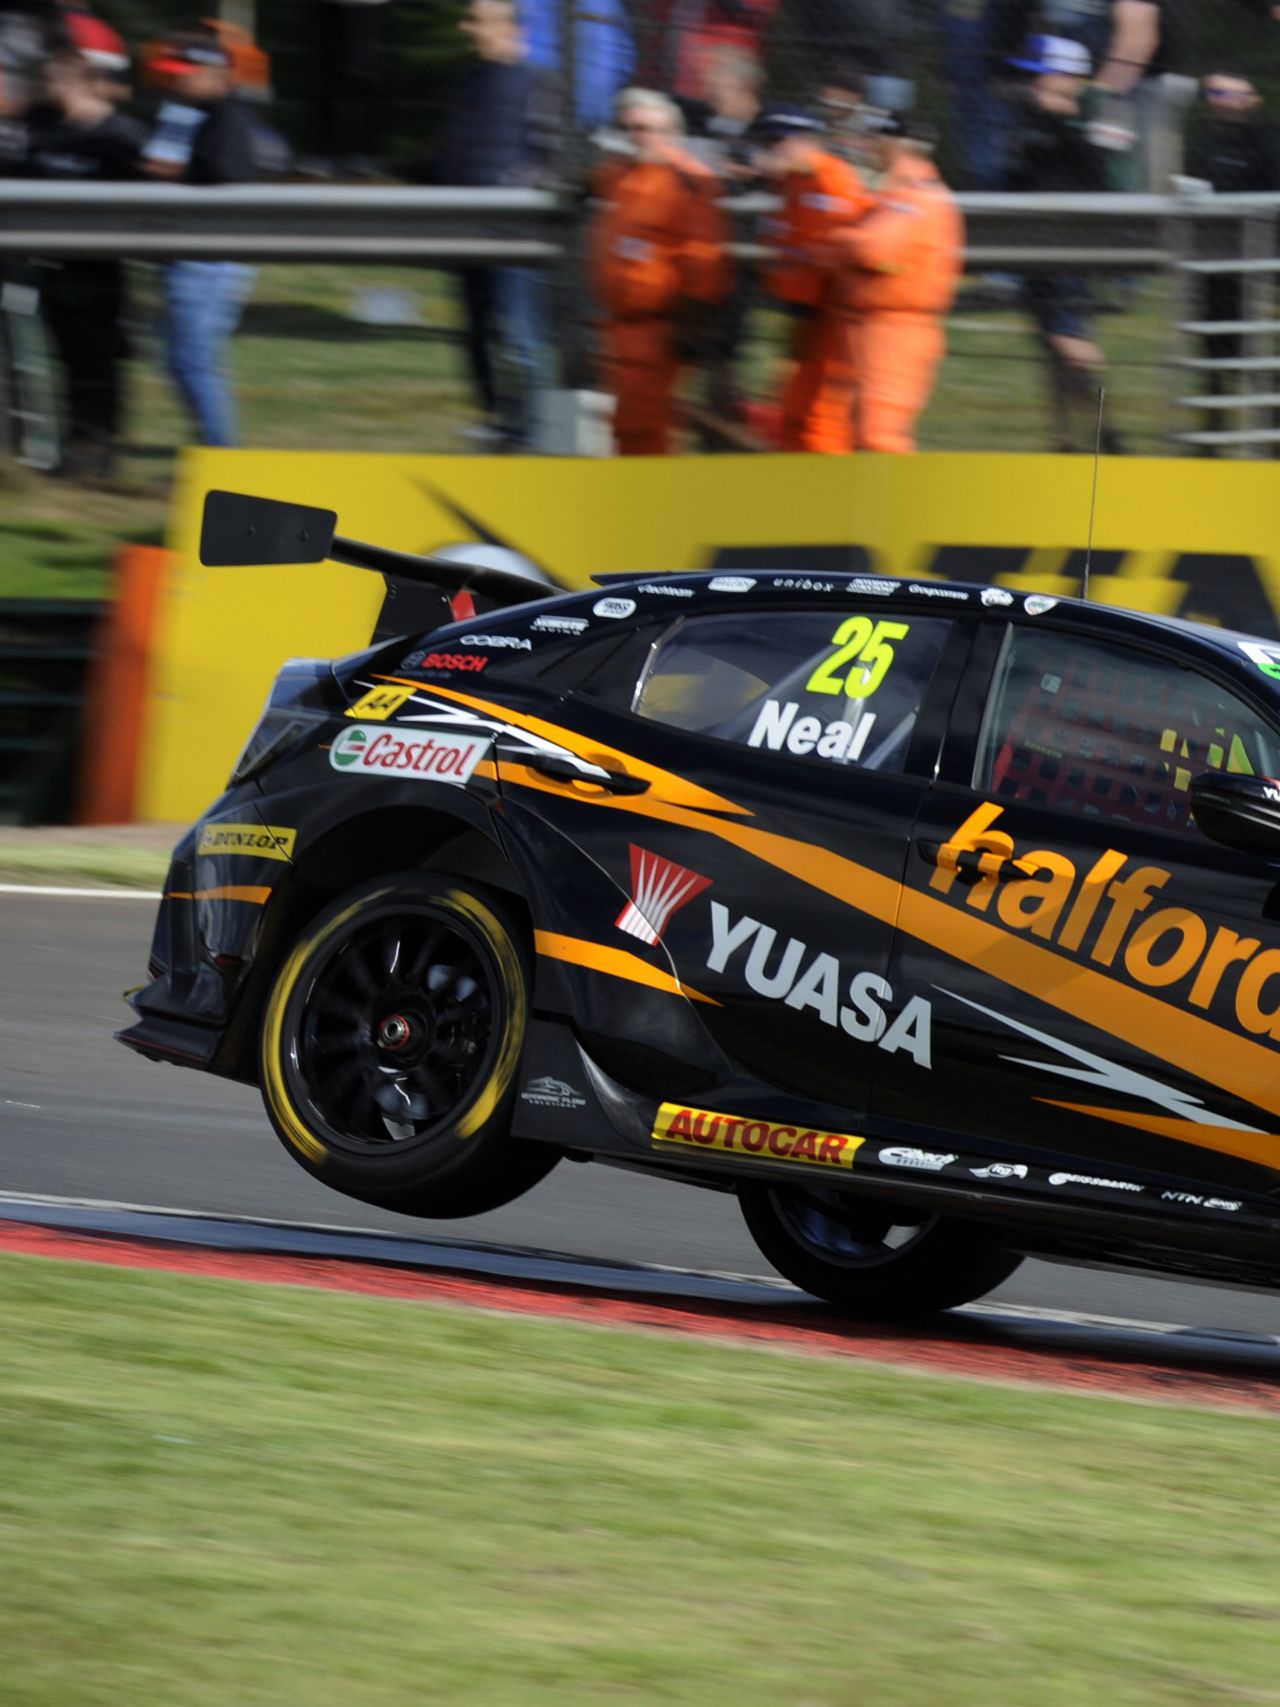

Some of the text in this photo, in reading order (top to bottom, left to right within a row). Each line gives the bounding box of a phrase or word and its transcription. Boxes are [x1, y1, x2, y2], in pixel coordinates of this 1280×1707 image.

[422, 653, 488, 672] BOSCH
[459, 634, 532, 651] COBRA
[805, 615, 910, 700] 25
[747, 699, 877, 762] Neal
[363, 732, 476, 776] Castrol
[212, 832, 289, 849] DUNLOP
[706, 900, 932, 1071] YUASA
[665, 1108, 849, 1165] AUTOCAR
[1161, 1190, 1202, 1205] NTN
